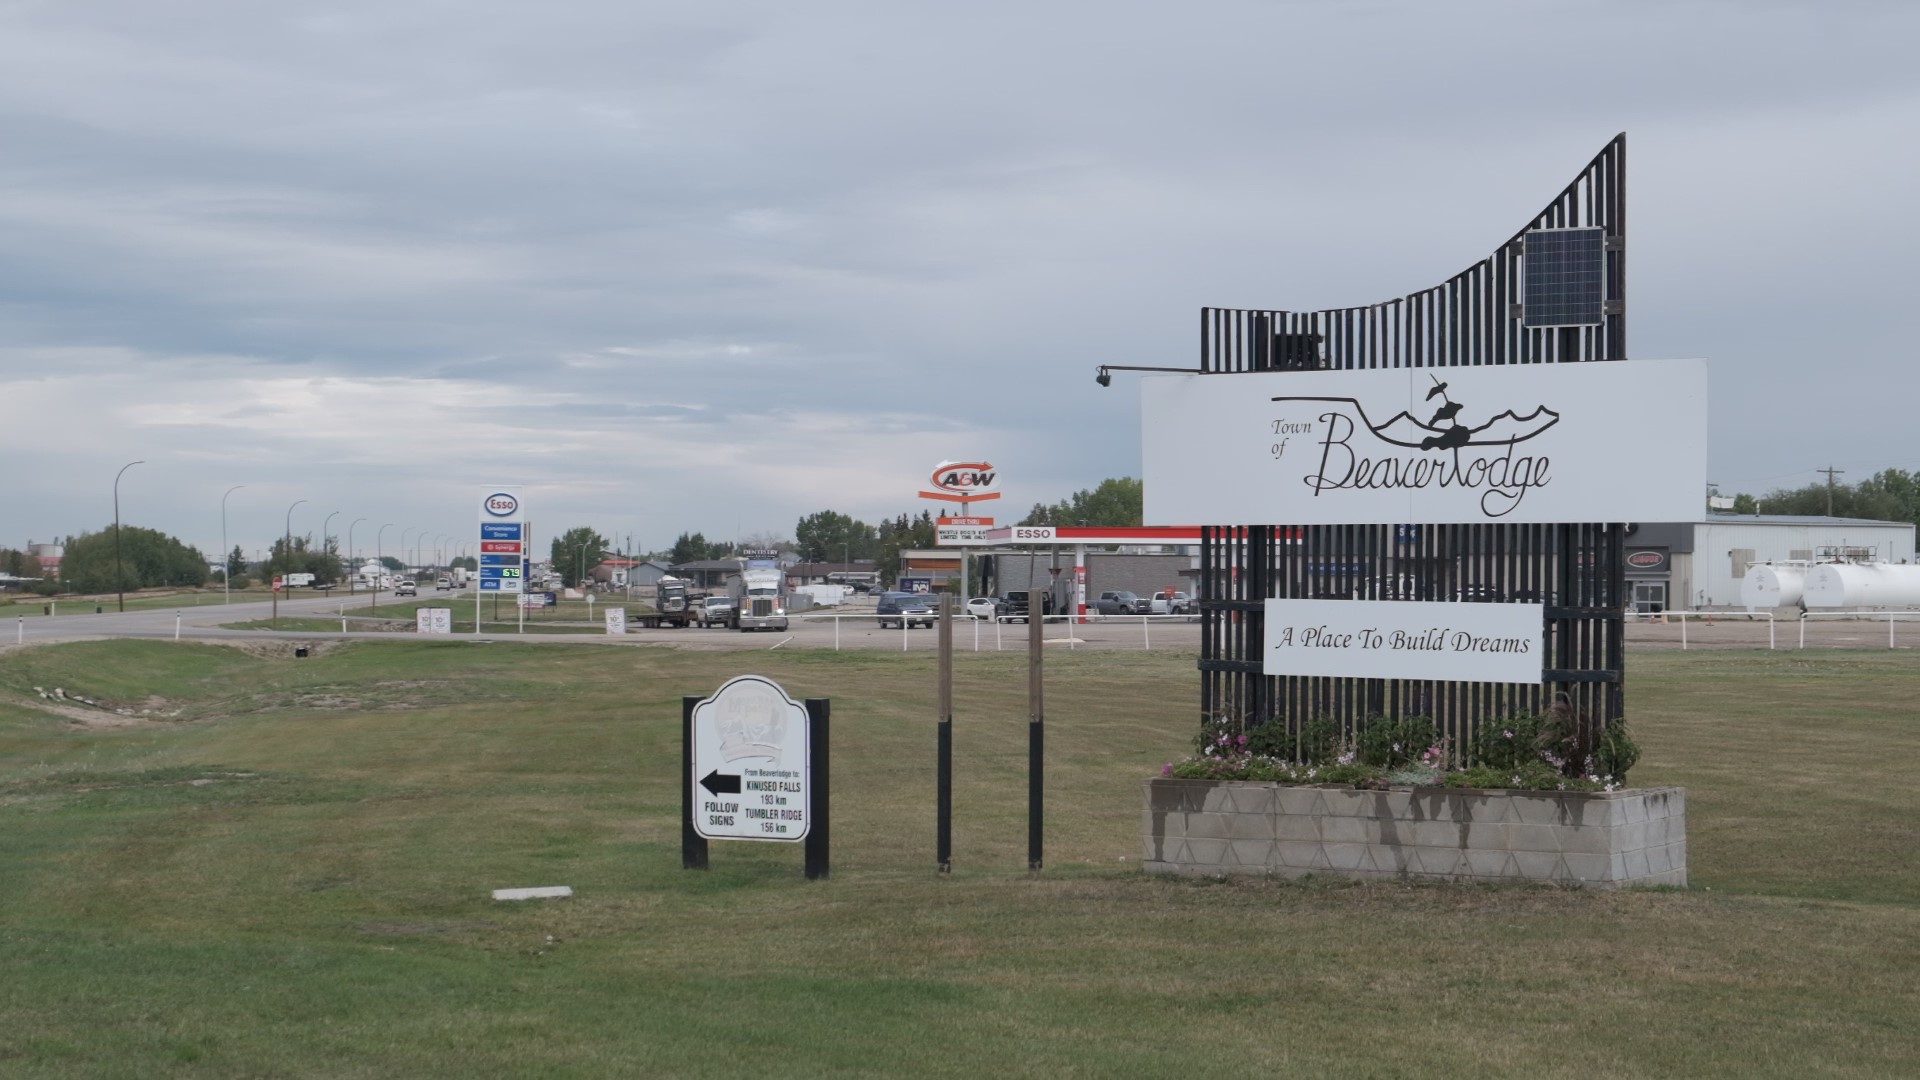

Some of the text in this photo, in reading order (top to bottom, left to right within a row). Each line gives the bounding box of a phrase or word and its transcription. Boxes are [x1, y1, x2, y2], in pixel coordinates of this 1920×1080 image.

[1271, 419, 1312, 435] Town
[1271, 438, 1289, 459] of
[1303, 412, 1552, 517] Beaverlodge
[942, 472, 996, 487] A&W
[490, 499, 514, 509] Esso
[1016, 529, 1051, 538] ESSO
[1275, 625, 1531, 654] A Place To Build Dreams
[759, 769, 791, 779] Beaverlodge
[746, 781, 801, 792] KINUSEO FALLS
[761, 794, 787, 805] 193 km
[705, 801, 739, 813] FOLLOW
[745, 808, 802, 820] TUMBLER RIDGE
[709, 815, 735, 826] SIGNS
[761, 822, 787, 833] 156 km
